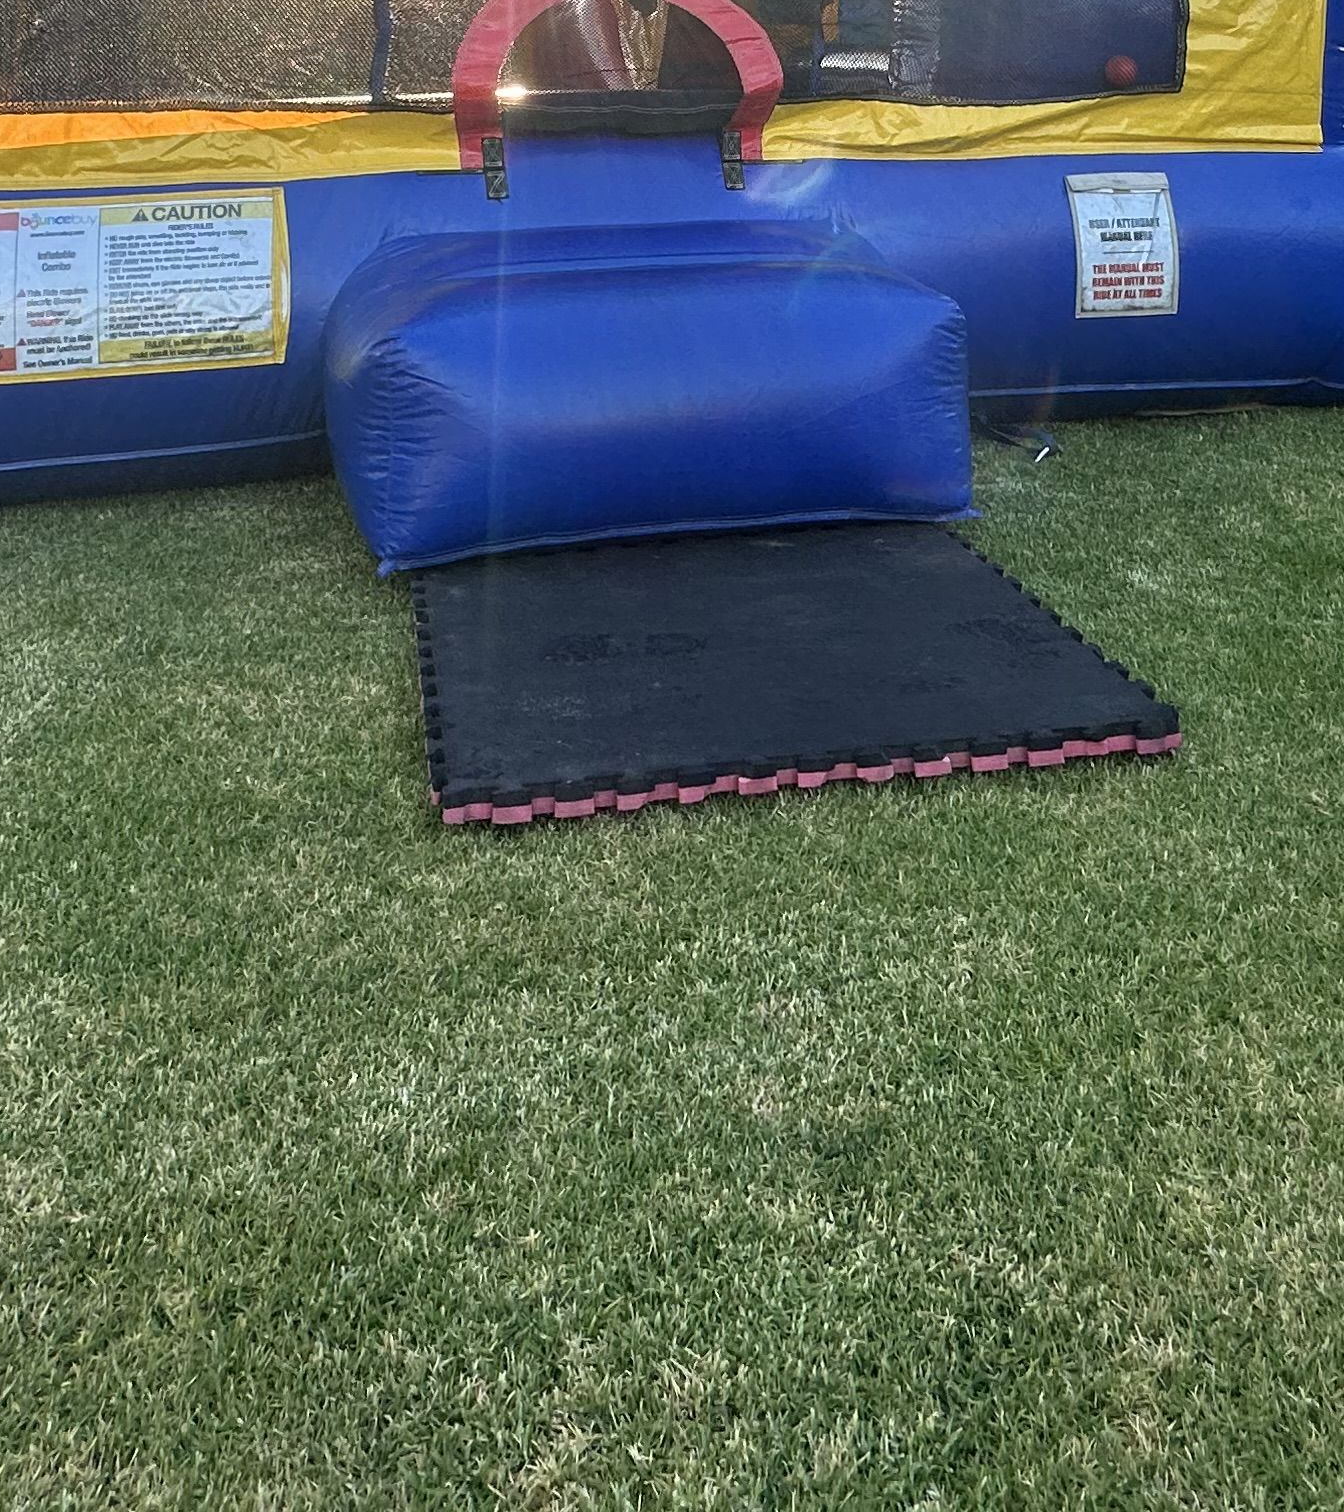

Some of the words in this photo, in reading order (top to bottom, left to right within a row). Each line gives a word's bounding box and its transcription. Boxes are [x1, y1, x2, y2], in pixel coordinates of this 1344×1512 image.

[152, 204, 241, 221] CAUTION
[21, 213, 97, 229] bouncebuy
[41, 263, 71, 272] Combo
[1093, 264, 1106, 274] THE
[1109, 263, 1140, 273] MANUAL
[1142, 262, 1164, 272] MUST
[1093, 277, 1122, 287] REMAIN
[1124, 276, 1144, 285] WITH
[1147, 275, 1164, 285] THIS
[1113, 290, 1122, 299] AT
[1124, 289, 1136, 299] ALL
[1139, 288, 1162, 298] TIMES
[67, 356, 92, 365] Manual
